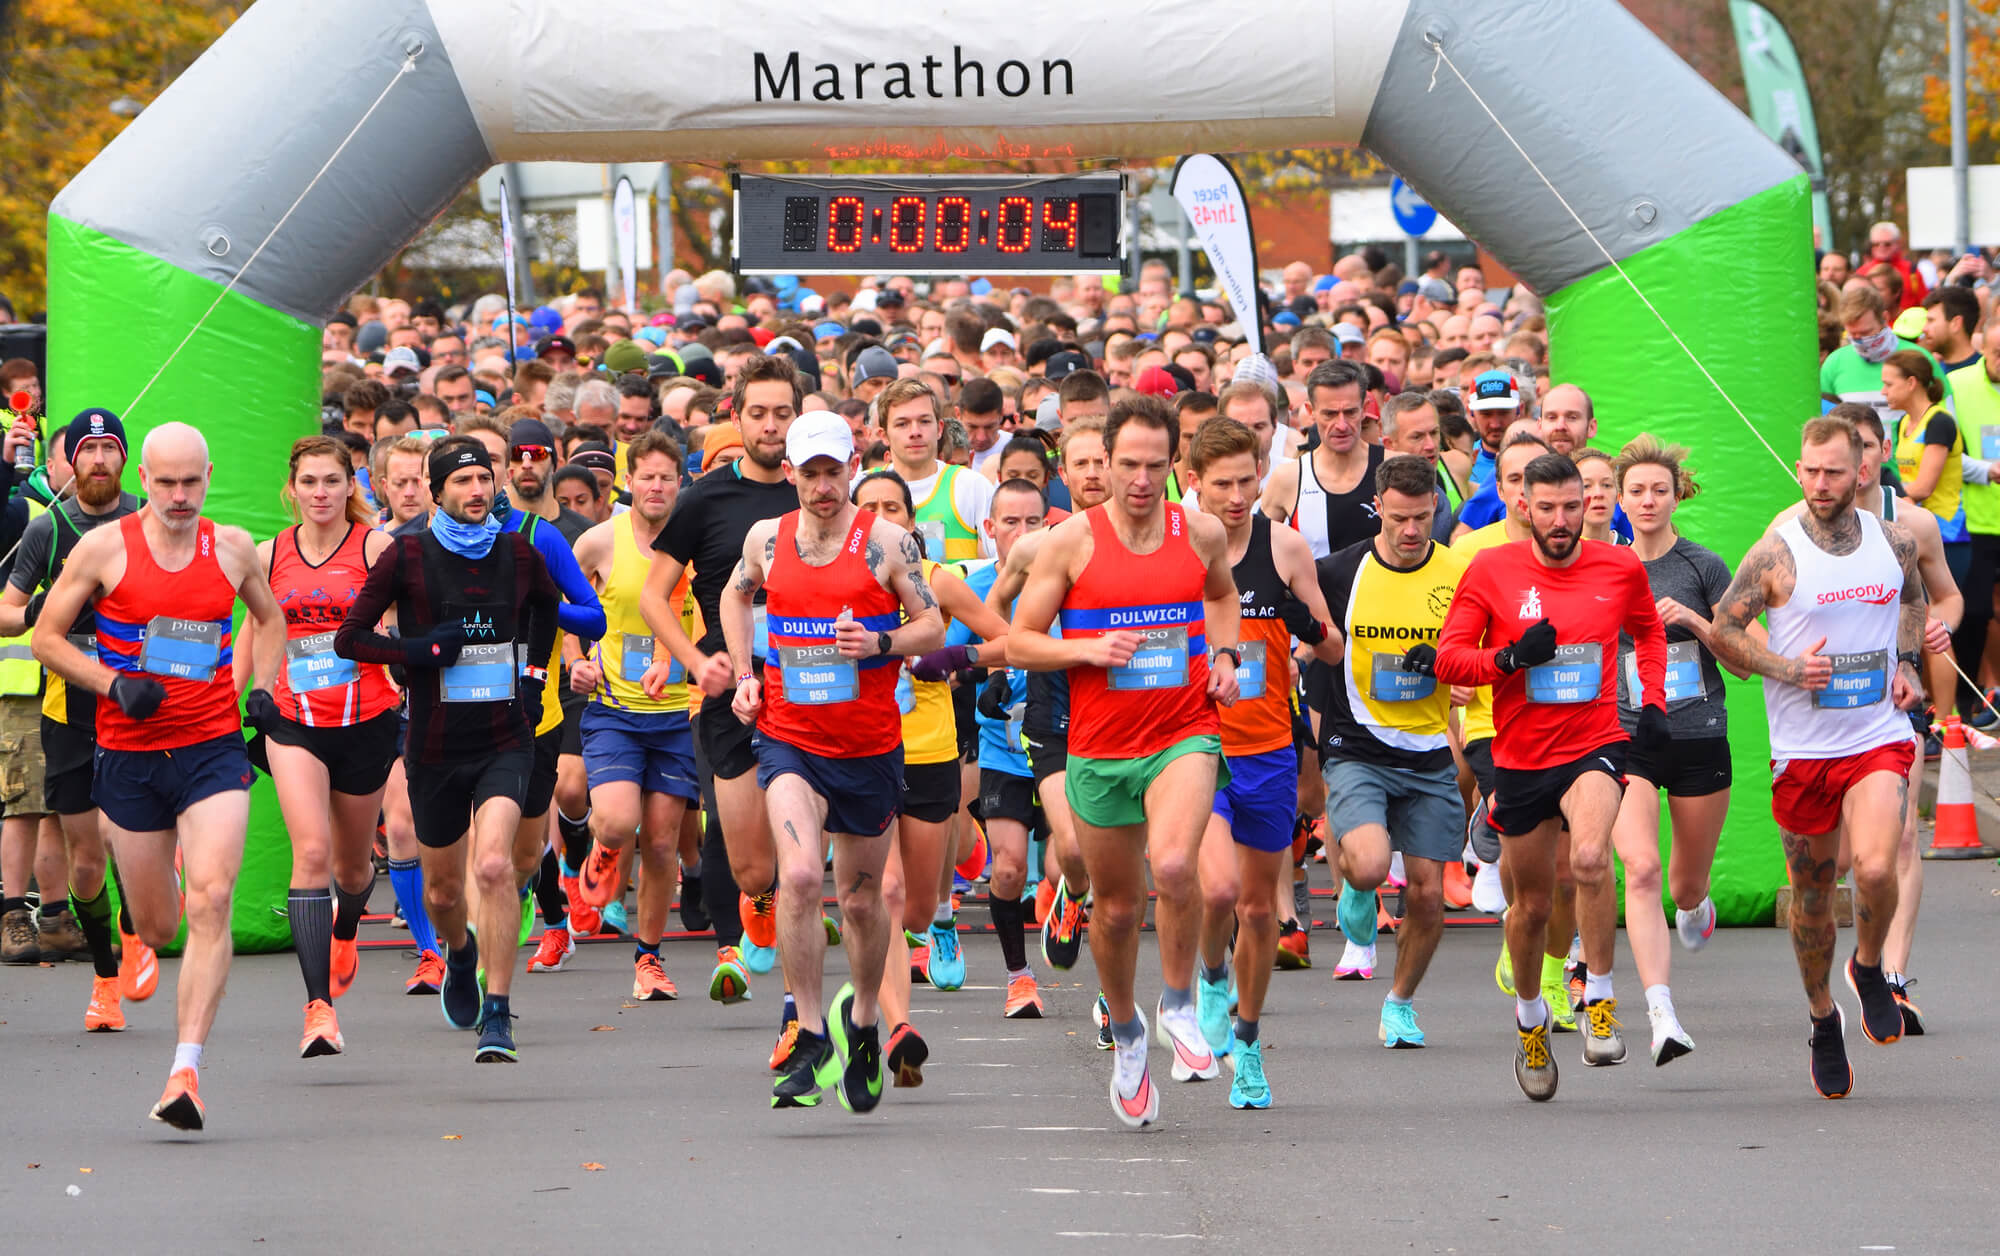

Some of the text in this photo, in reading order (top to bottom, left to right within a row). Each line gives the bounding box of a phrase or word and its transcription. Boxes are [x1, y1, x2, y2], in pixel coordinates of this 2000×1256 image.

[753, 45, 1074, 102] Marathon
[827, 196, 1078, 253] 0:00:04
[848, 527, 864, 554] soar
[1816, 583, 1884, 605] saucony
[287, 605, 352, 619] OSTO
[1110, 607, 1187, 625] DULWICH
[1519, 604, 1542, 617] AJH
[171, 619, 208, 633] pico
[783, 621, 836, 635] DULWI
[301, 634, 334, 649] pico
[1142, 629, 1169, 640] ico
[462, 646, 497, 658] pico
[796, 646, 835, 659] pico
[307, 657, 334, 672] Katie
[1835, 655, 1871, 667] pico
[799, 671, 836, 684] Shane
[1395, 675, 1423, 686] Peter
[1553, 670, 1580, 682] Tony
[1833, 677, 1871, 691] Martyn
[471, 687, 491, 699] 1474
[809, 690, 828, 701] 955
